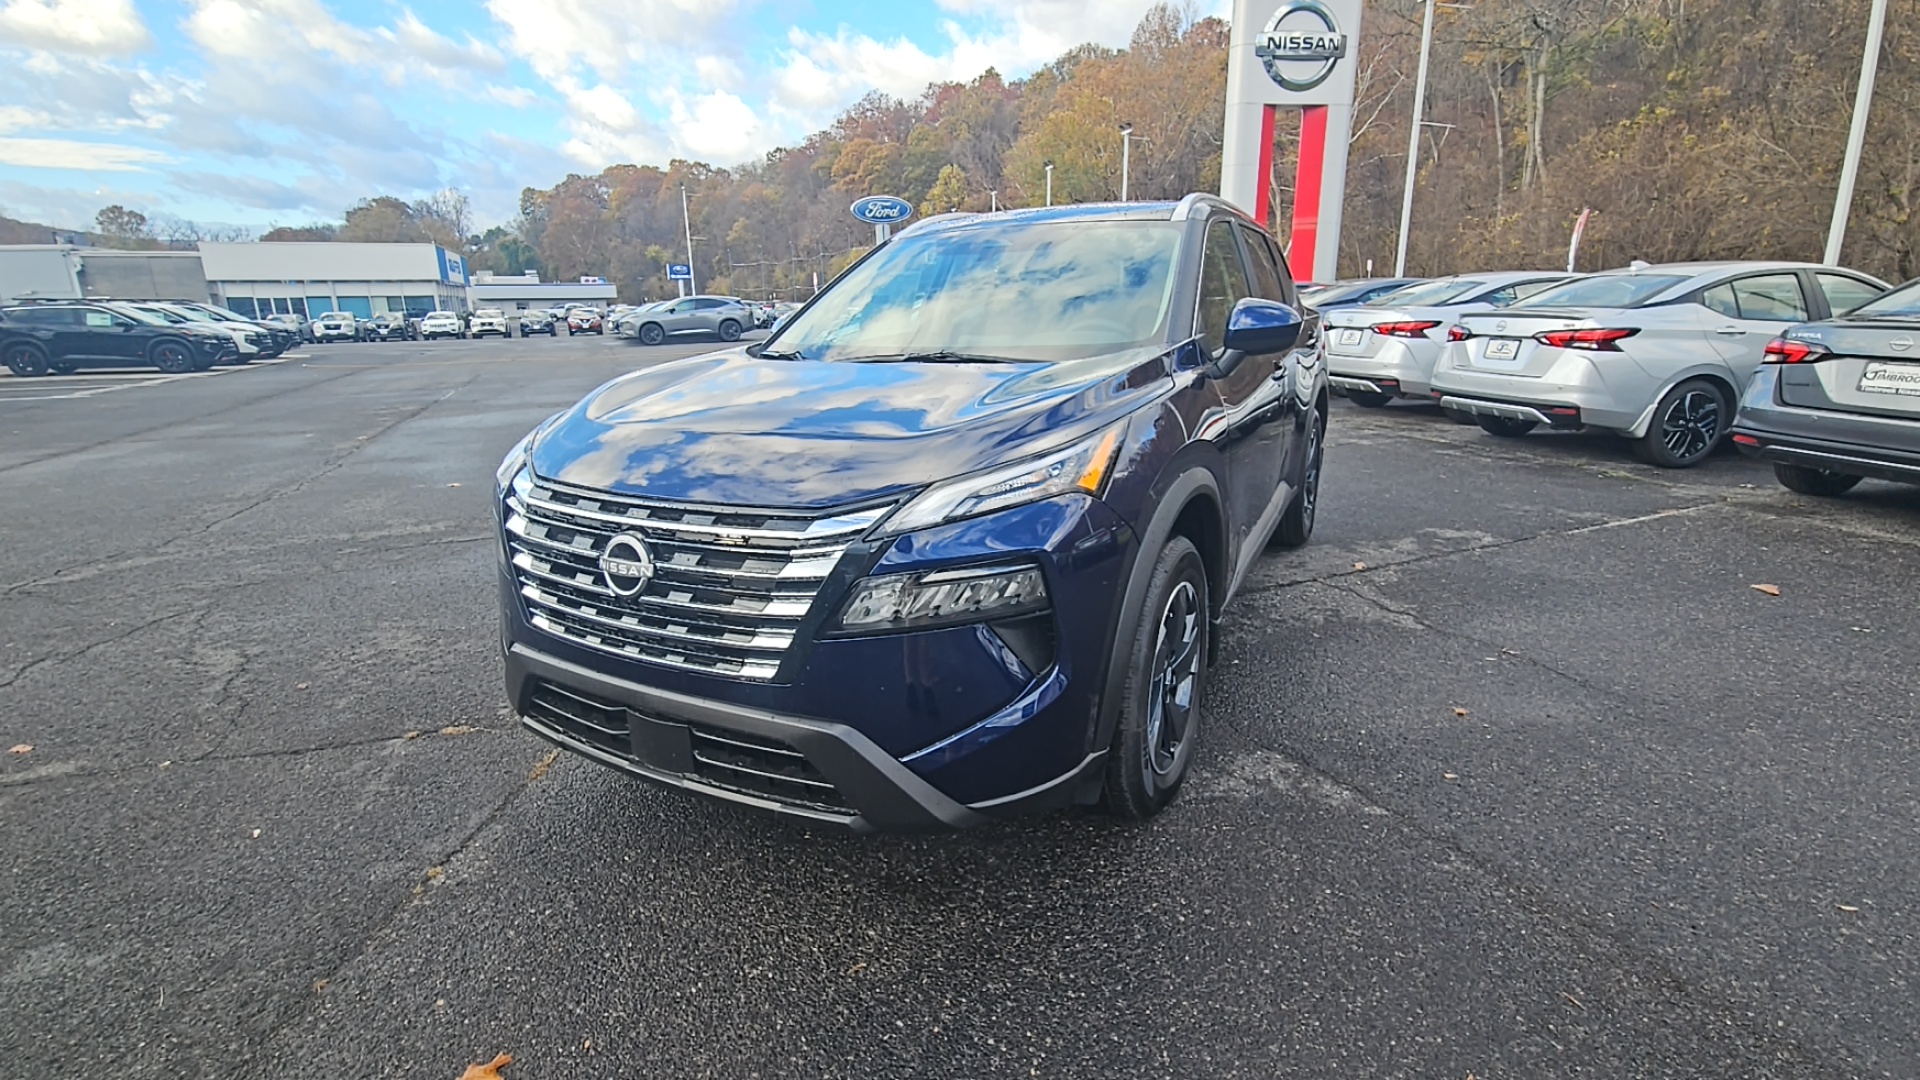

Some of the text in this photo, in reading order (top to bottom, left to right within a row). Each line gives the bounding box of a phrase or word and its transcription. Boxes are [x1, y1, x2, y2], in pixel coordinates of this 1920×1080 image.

[1267, 36, 1339, 51] NISSAN
[865, 201, 900, 218] Ford
[602, 560, 651, 577] NISSAN
